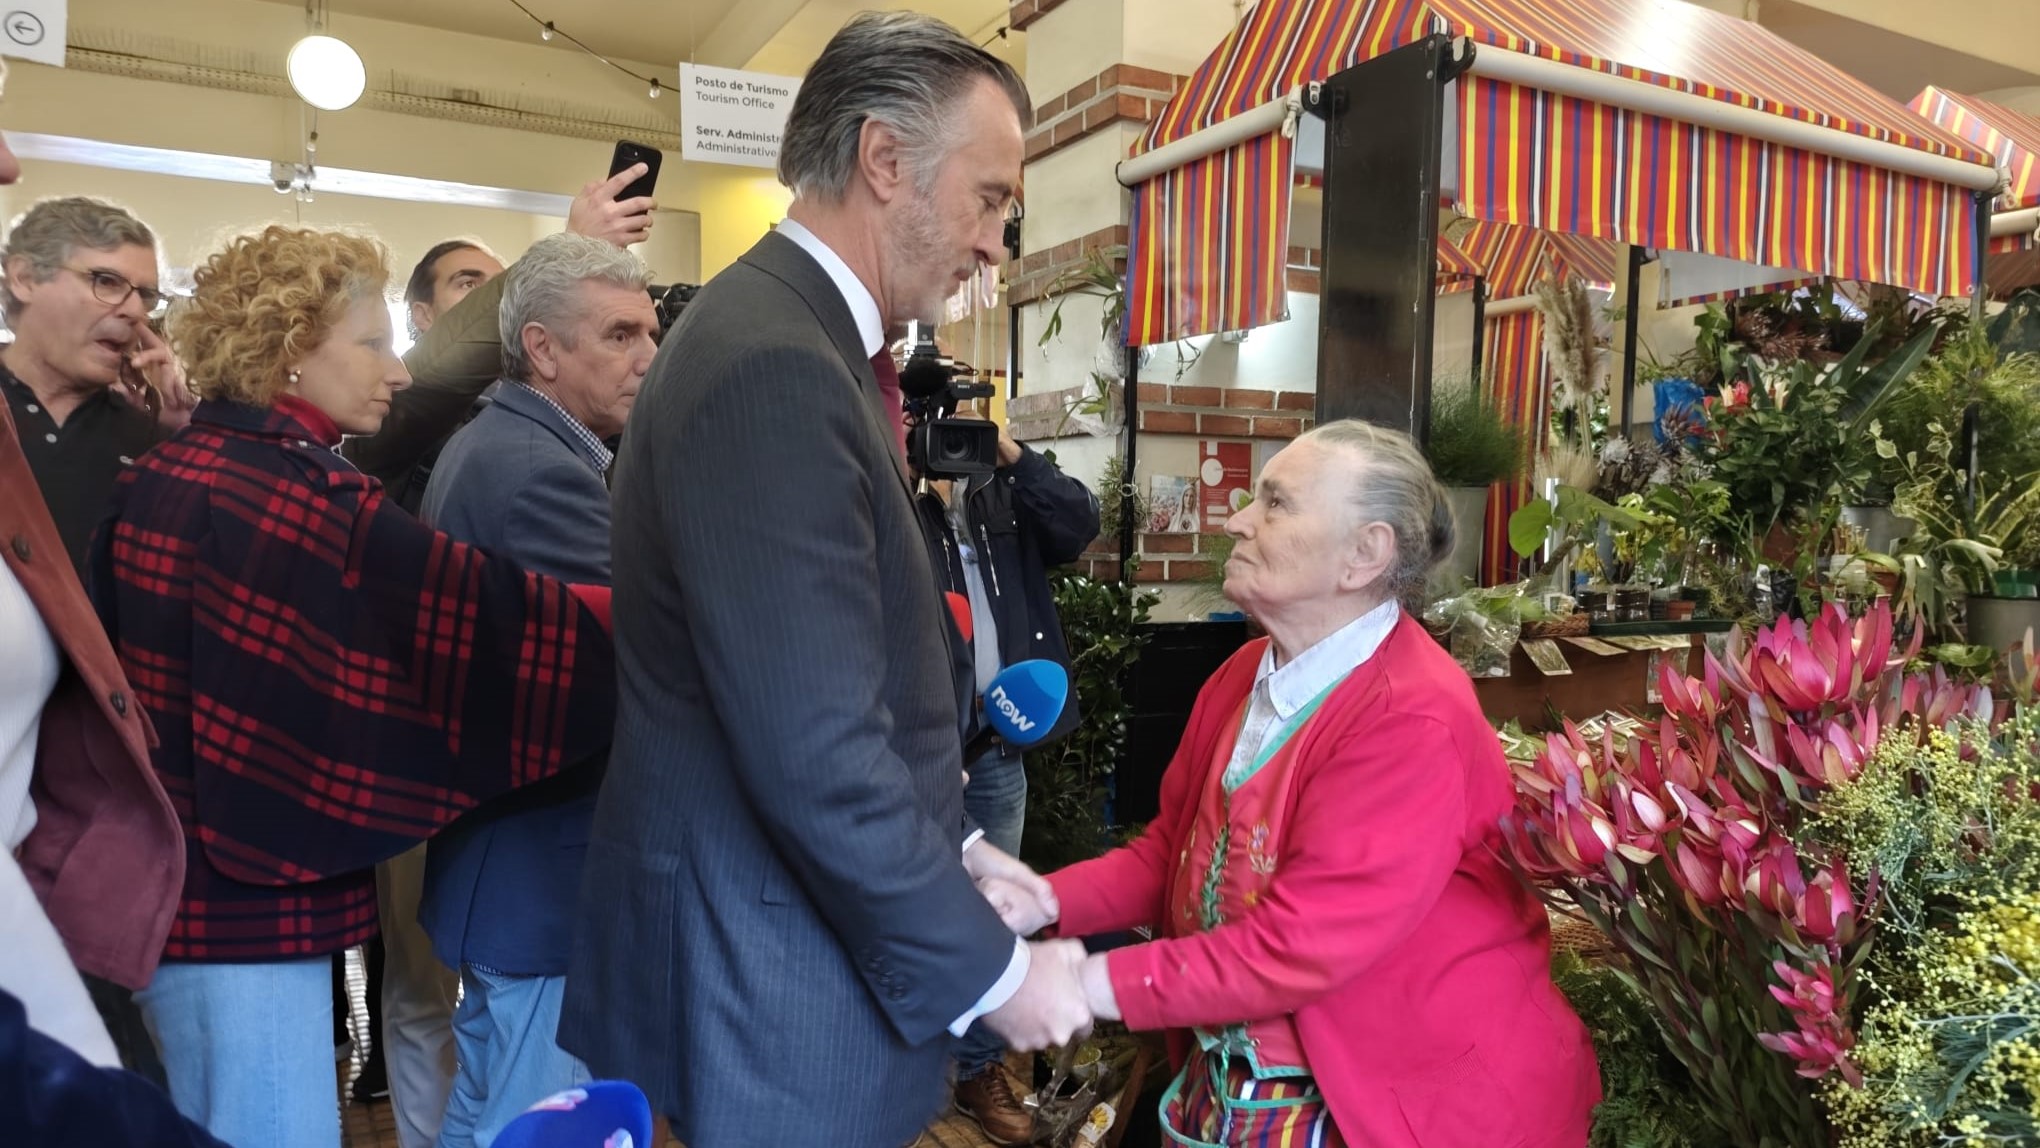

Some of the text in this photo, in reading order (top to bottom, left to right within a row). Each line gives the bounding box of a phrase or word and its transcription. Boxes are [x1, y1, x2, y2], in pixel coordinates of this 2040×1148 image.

[696, 76, 789, 97] Posto de Turismo
[696, 91, 775, 109] Tourism Office
[696, 125, 784, 144] Serv. Administr
[696, 140, 777, 157] Administrative
[991, 685, 1036, 732] now
